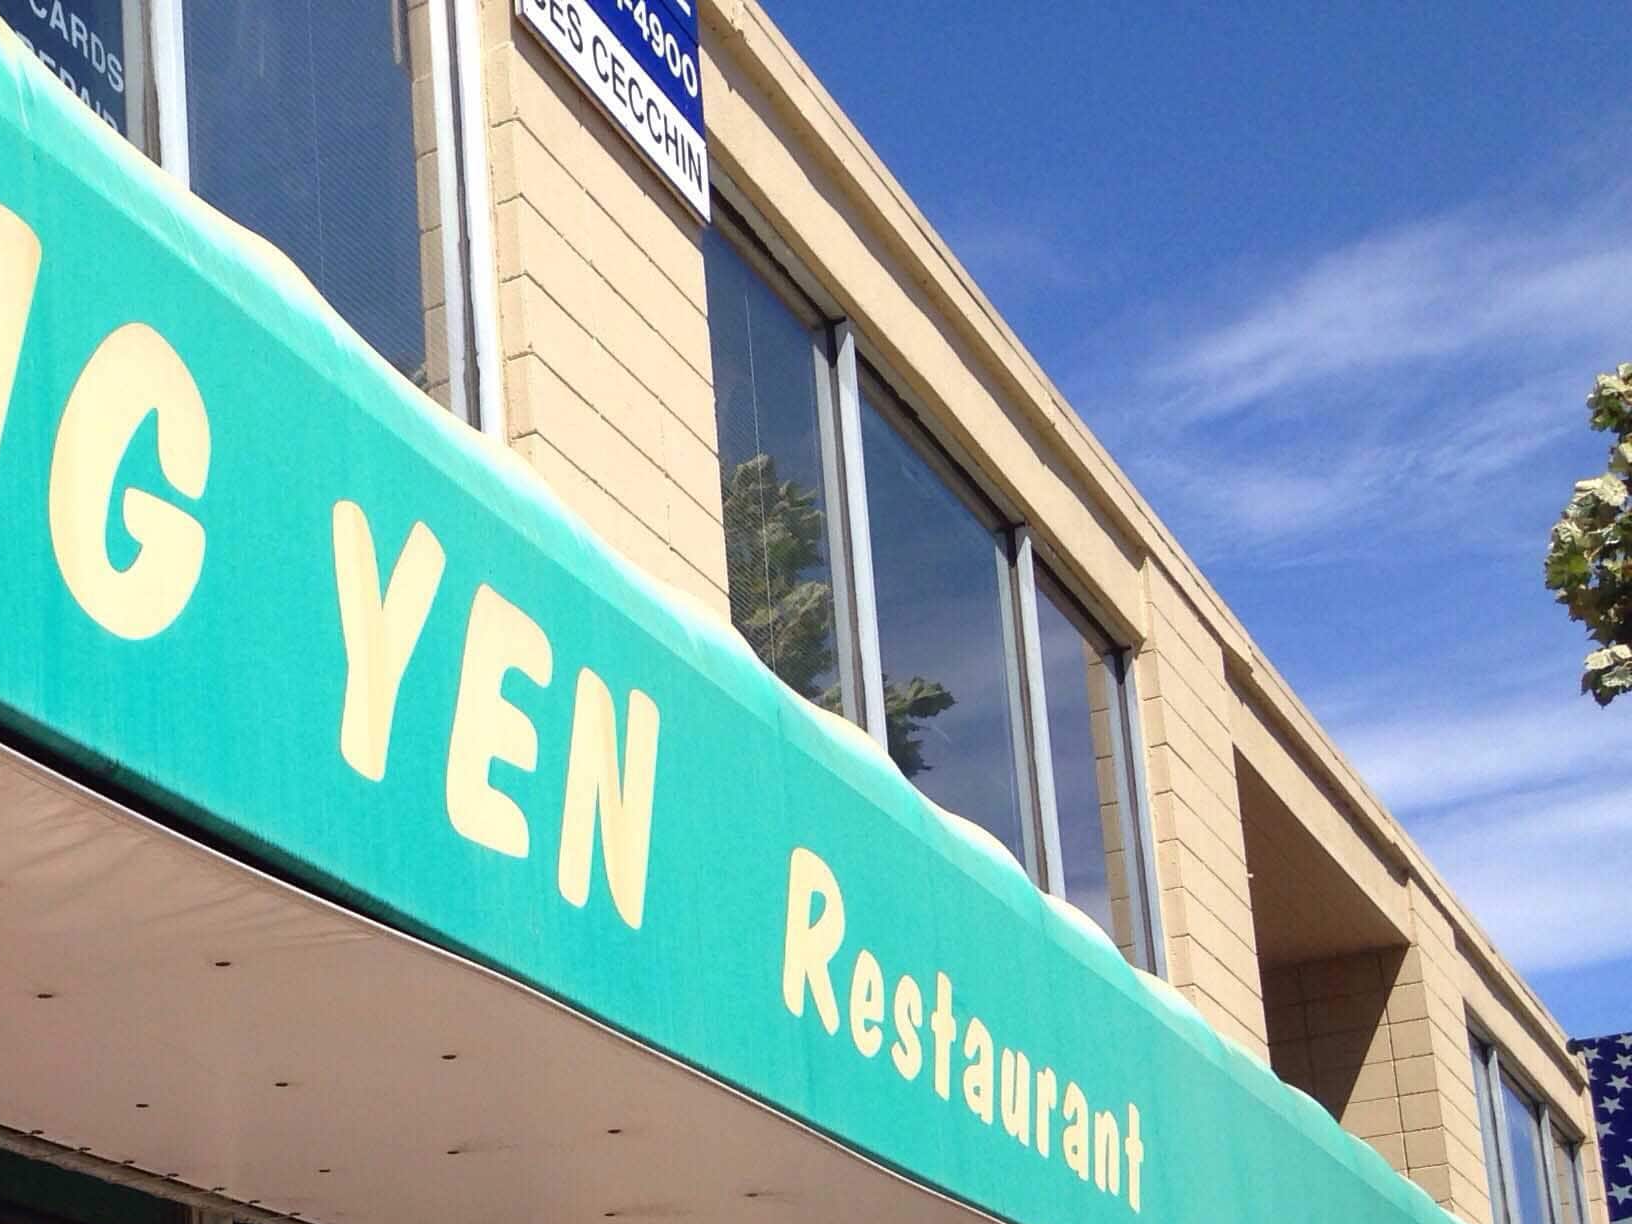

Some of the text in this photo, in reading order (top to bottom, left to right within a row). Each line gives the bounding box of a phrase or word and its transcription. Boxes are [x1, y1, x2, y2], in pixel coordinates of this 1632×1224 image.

[592, 34, 704, 194] CECCHIN
[332, 499, 660, 931] YEN
[782, 846, 1146, 1214] Restaurant
